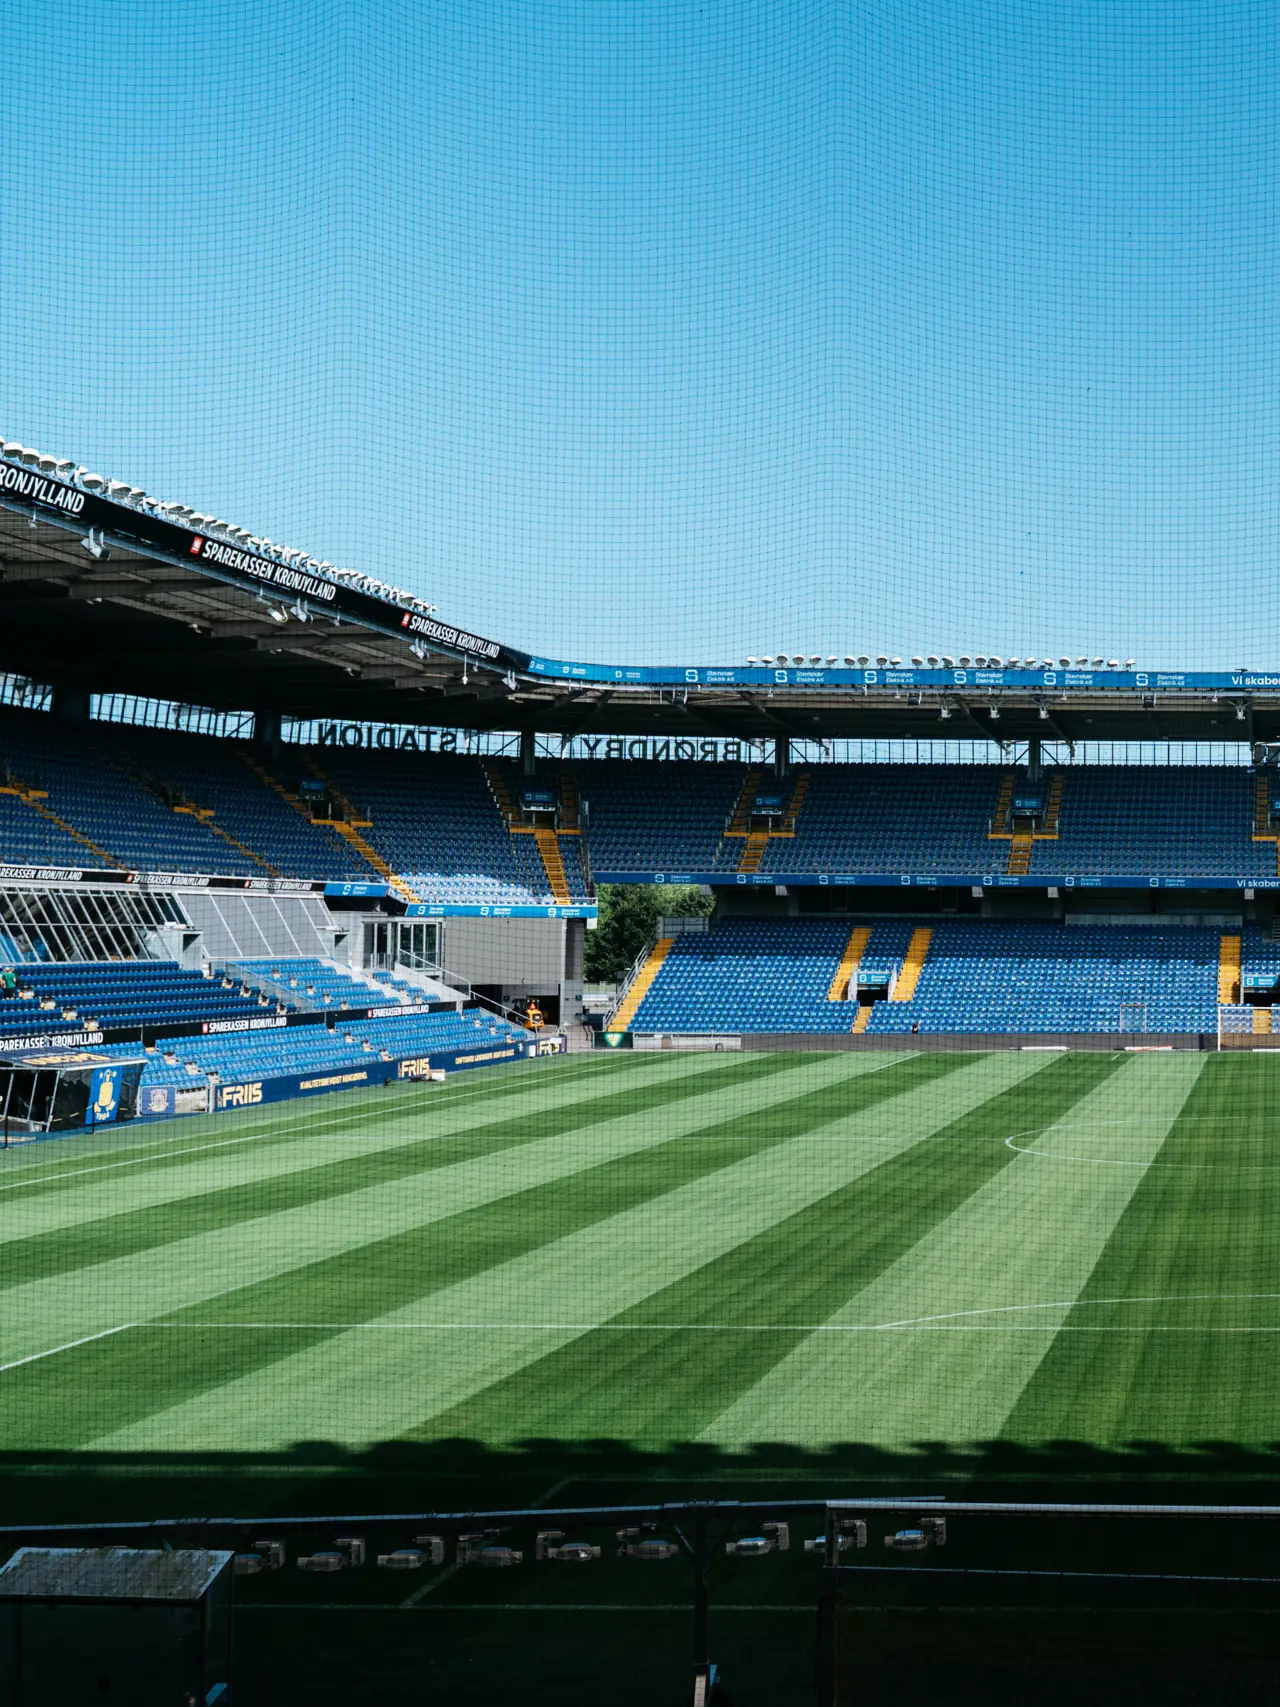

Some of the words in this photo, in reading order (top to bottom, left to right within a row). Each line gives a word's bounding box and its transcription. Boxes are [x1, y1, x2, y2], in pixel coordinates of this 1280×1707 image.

[202, 541, 274, 579] SPAREKASSEN
[274, 566, 336, 600] KRONJYLLAND
[409, 615, 458, 644] SPAREKASSEN
[456, 632, 500, 658] KRONJYLLAND
[1232, 676, 1243, 685] Vi
[0, 865, 36, 880] REKASSEN
[36, 870, 83, 881] KRONJYLLAND
[133, 874, 172, 885] SPAREKASSEN
[172, 876, 210, 887] KRONJYLLAND
[1248, 879, 1280, 888] skaber
[209, 1018, 249, 1033] SPAREKASSEN
[250, 1016, 287, 1029] KRONJYLLAND
[52, 1032, 104, 1048] KRONJYLLAND
[401, 1058, 429, 1077] FRIIS
[222, 1083, 263, 1107] FRIIS
